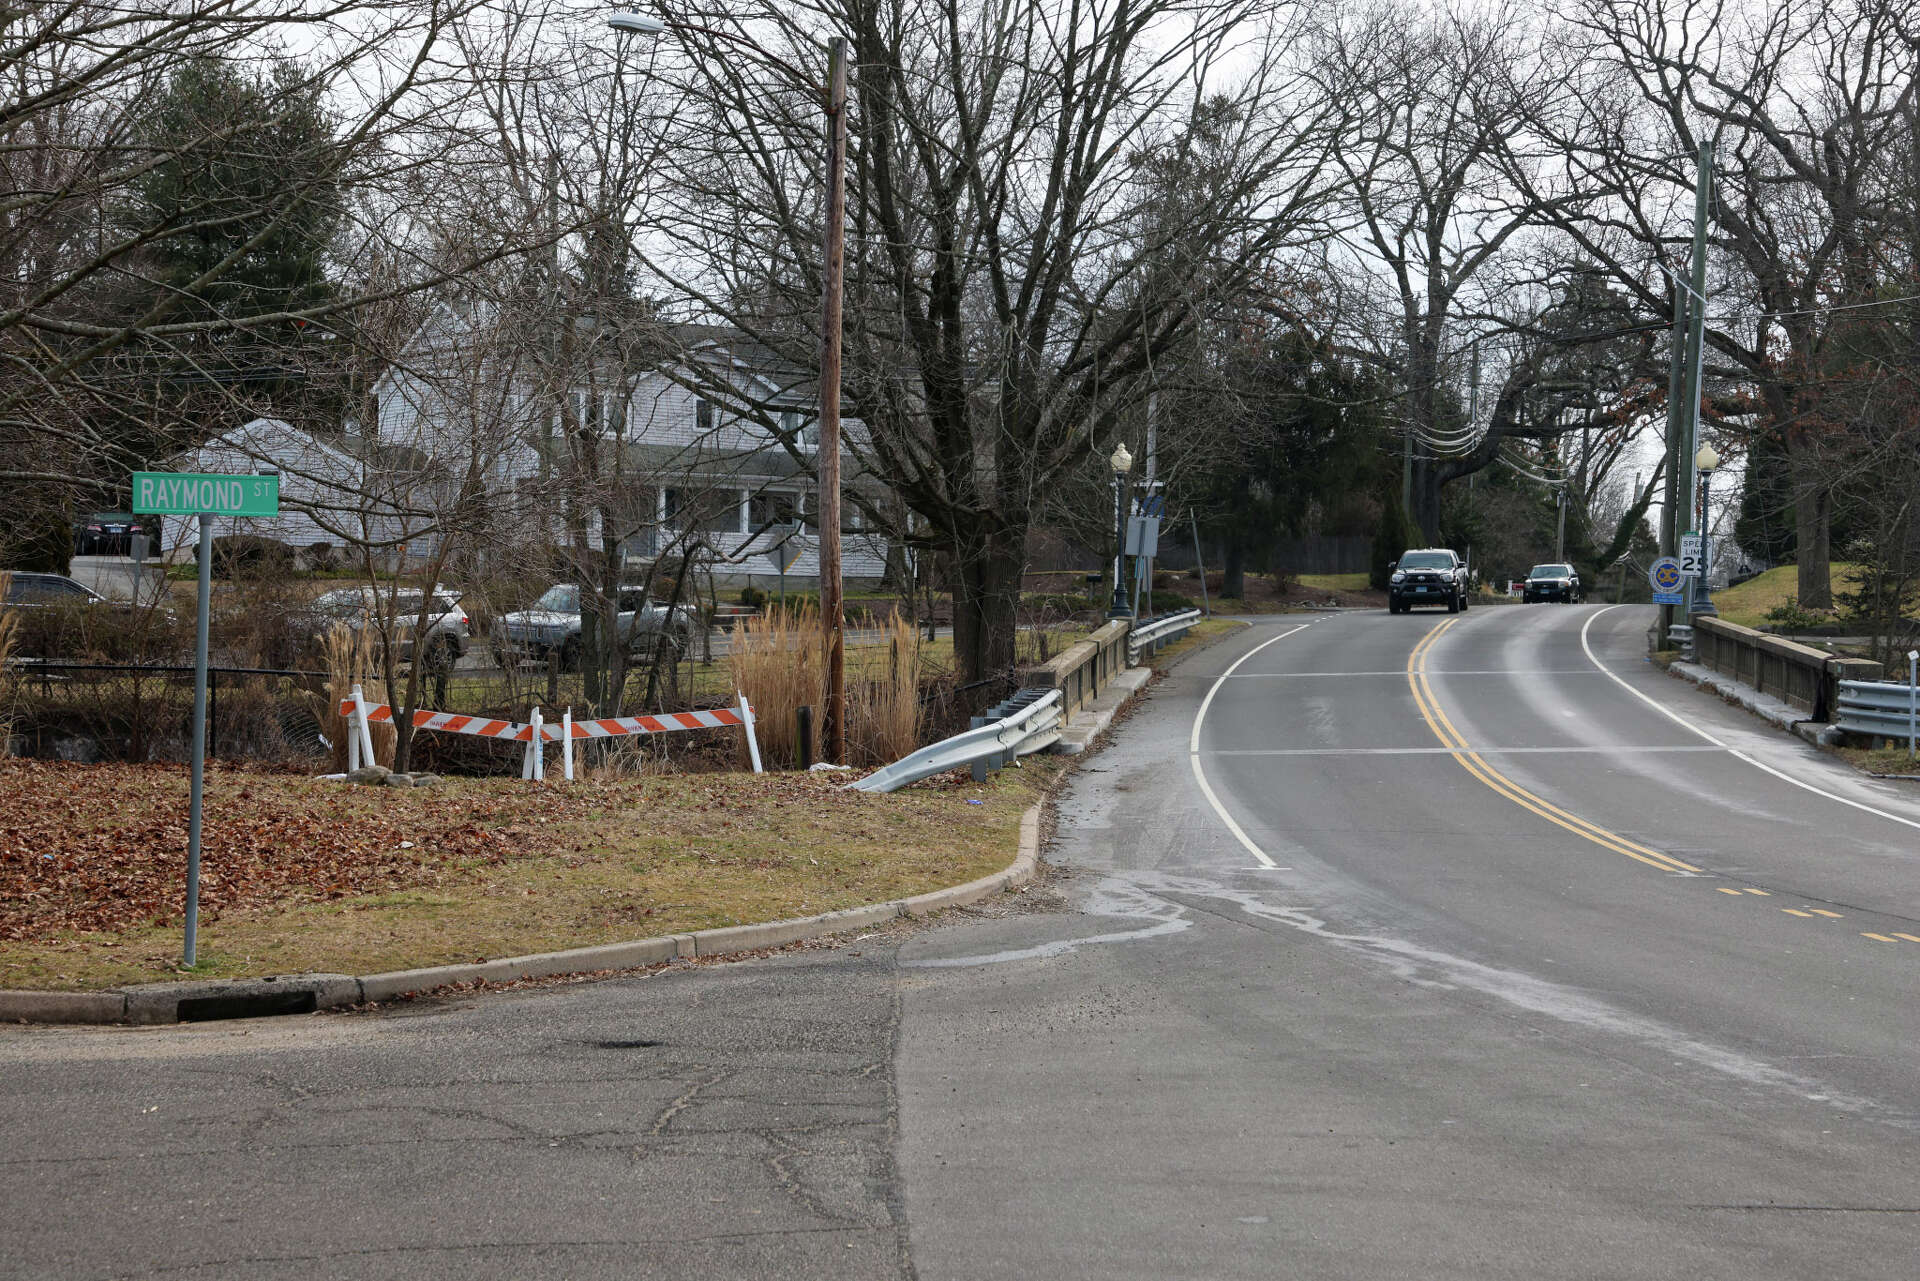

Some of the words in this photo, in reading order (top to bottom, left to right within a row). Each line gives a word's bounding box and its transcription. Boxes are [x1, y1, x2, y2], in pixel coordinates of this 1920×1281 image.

[141, 478, 243, 510] RAYMOND
[254, 482, 271, 497] ST
[1683, 540, 1711, 548] SPED
